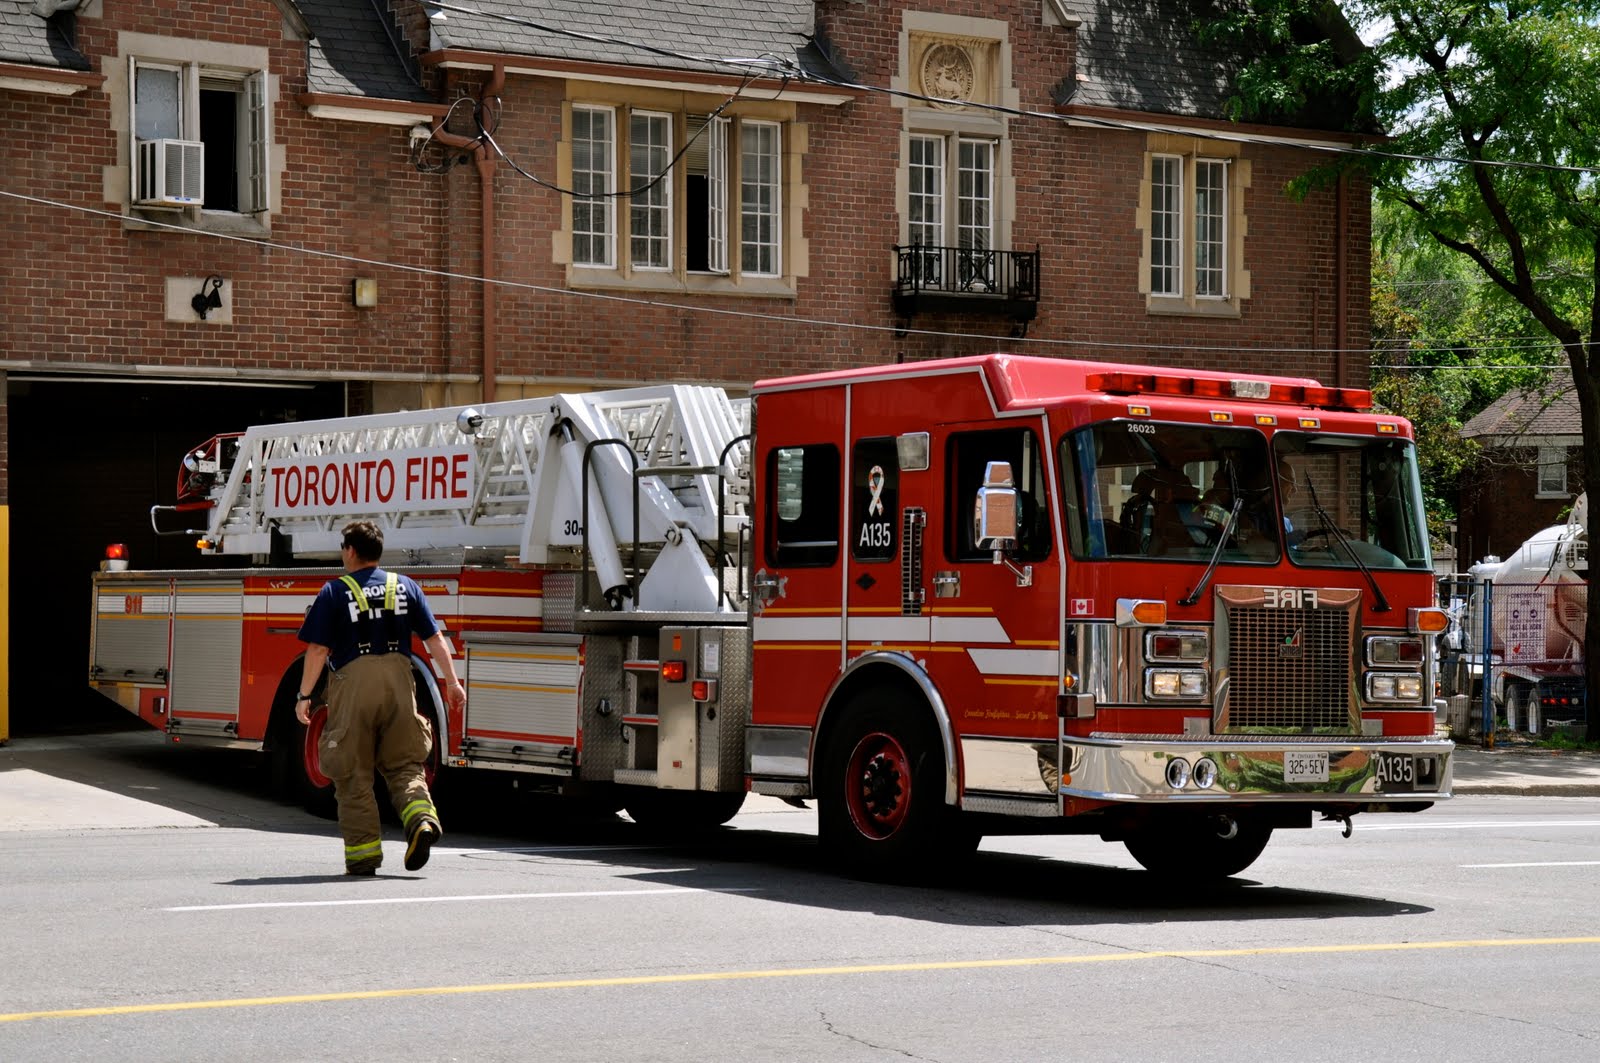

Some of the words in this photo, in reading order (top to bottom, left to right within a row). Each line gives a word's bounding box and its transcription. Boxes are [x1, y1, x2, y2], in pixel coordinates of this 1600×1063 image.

[1127, 423, 1156, 434] 26023
[271, 458, 395, 508] TORONTO
[405, 453, 469, 501] FIRE
[859, 522, 891, 547] A135
[124, 594, 143, 615] 911
[1375, 756, 1413, 783] A135
